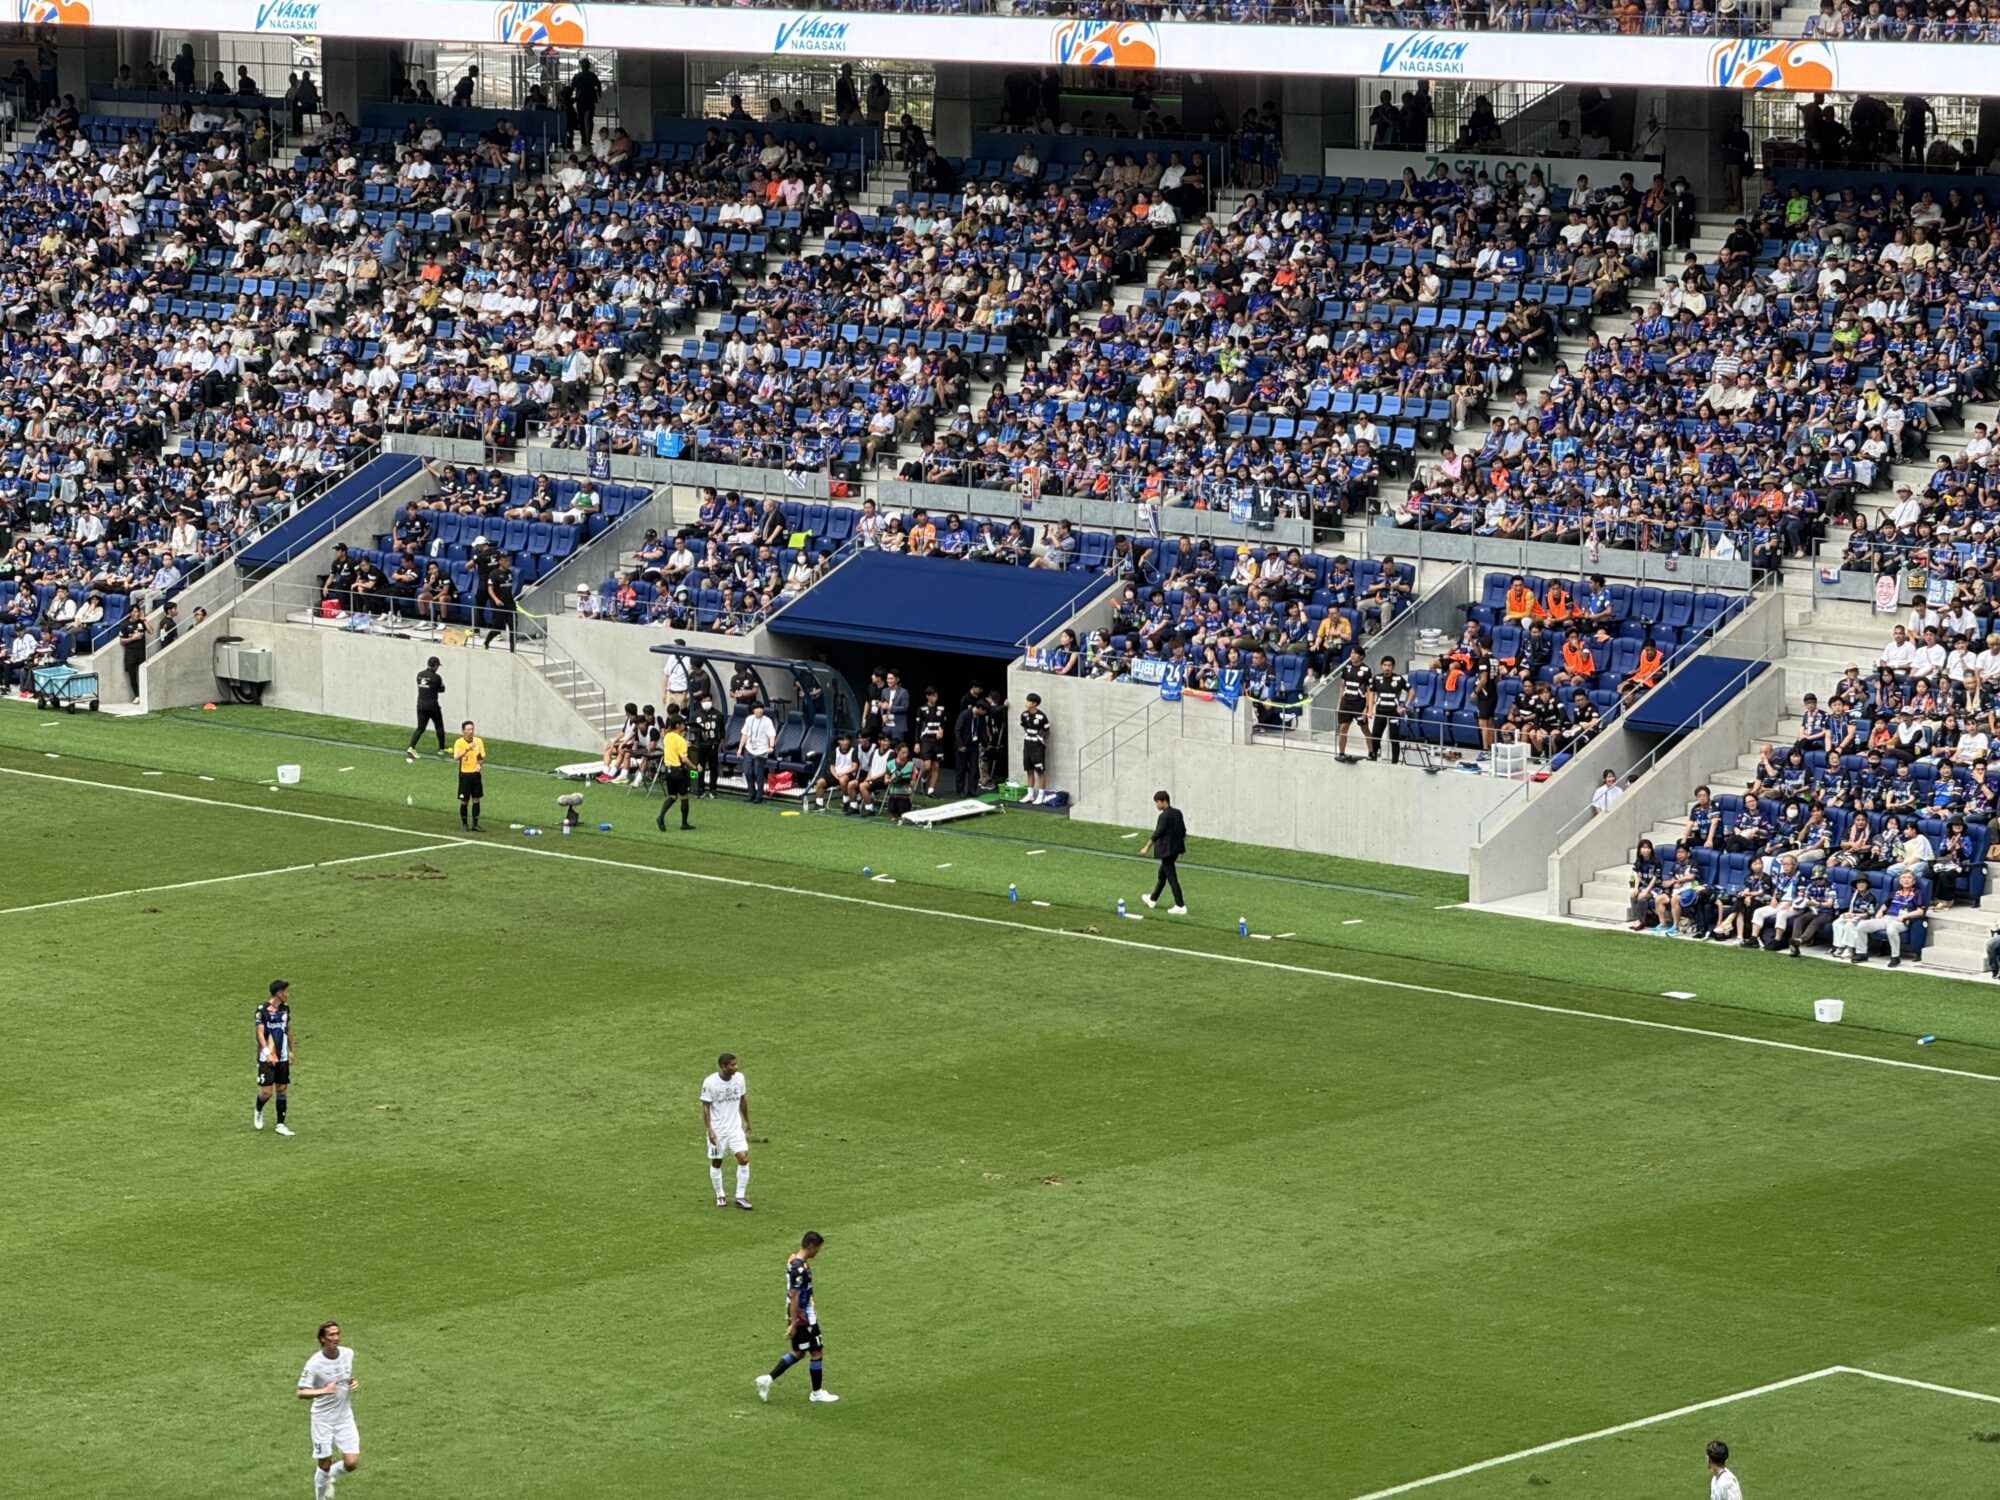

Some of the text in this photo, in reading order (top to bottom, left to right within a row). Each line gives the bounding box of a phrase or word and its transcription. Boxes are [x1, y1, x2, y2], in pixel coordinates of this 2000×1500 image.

[270, 19, 317, 30] NAGASAKI
[791, 39, 846, 51] NAGASAKI
[1399, 60, 1464, 73] NAGASAKI
[1259, 489, 1272, 507] 14
[1166, 664, 1181, 682] 24
[1225, 669, 1239, 685] 17
